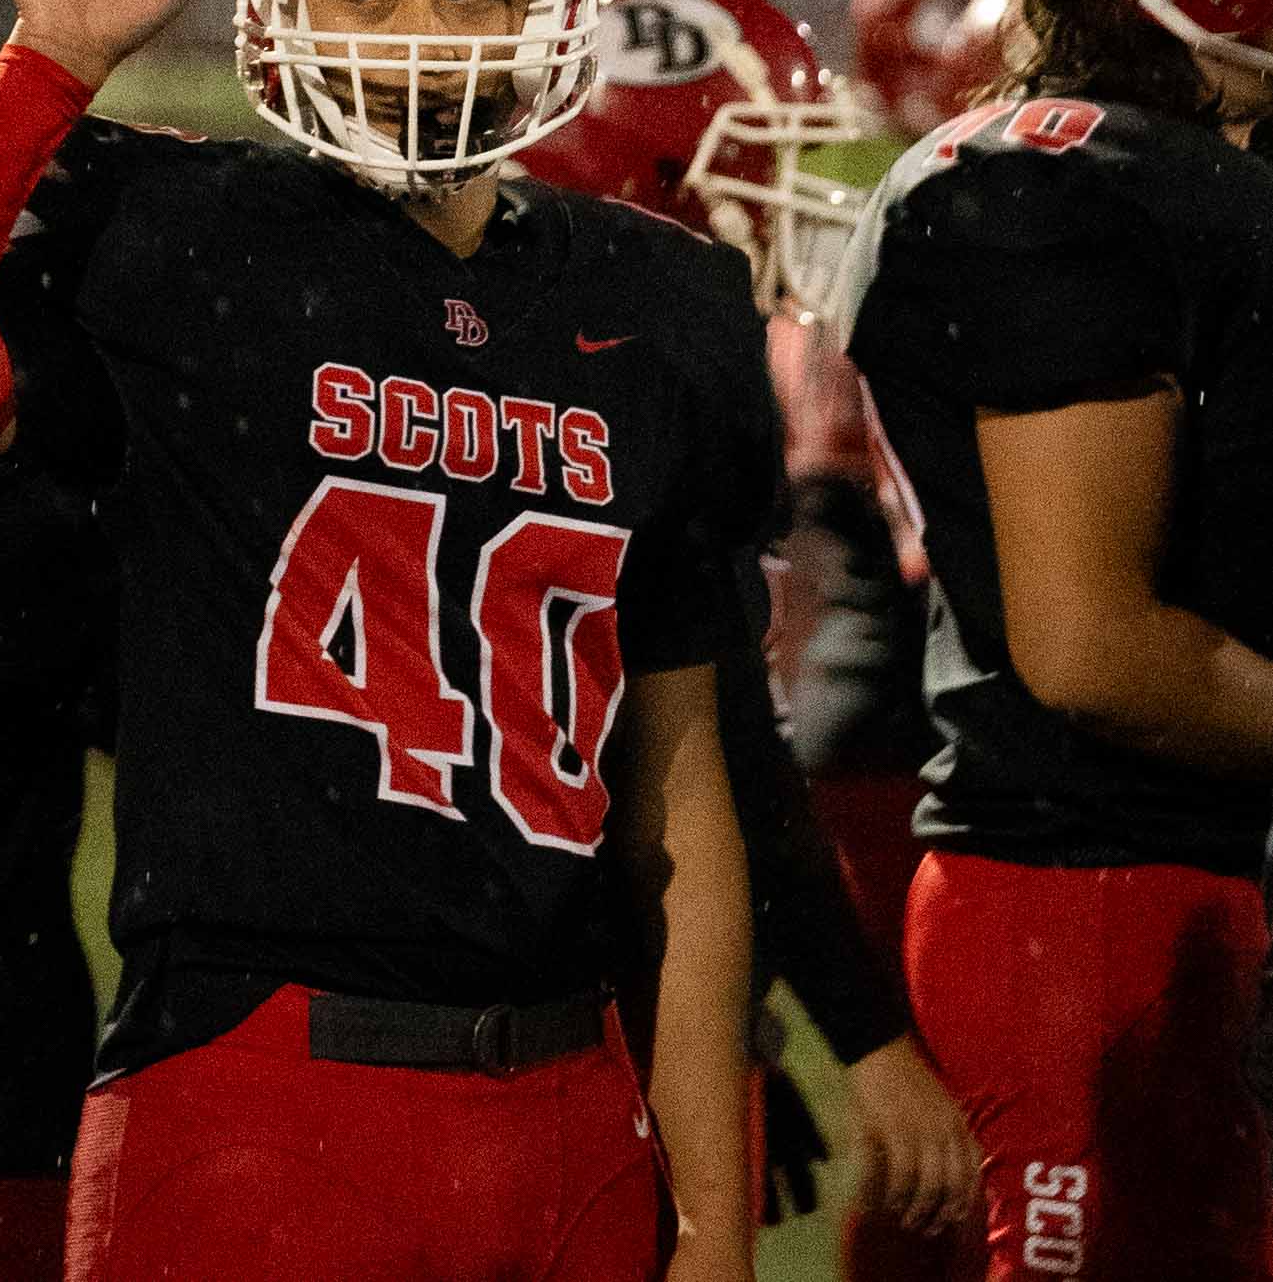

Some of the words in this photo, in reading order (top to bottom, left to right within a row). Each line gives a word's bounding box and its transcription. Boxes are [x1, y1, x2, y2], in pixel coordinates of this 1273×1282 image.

[308, 362, 614, 506] SCOTS
[255, 475, 632, 857] 40
[1023, 1161, 1088, 1282] SCO
